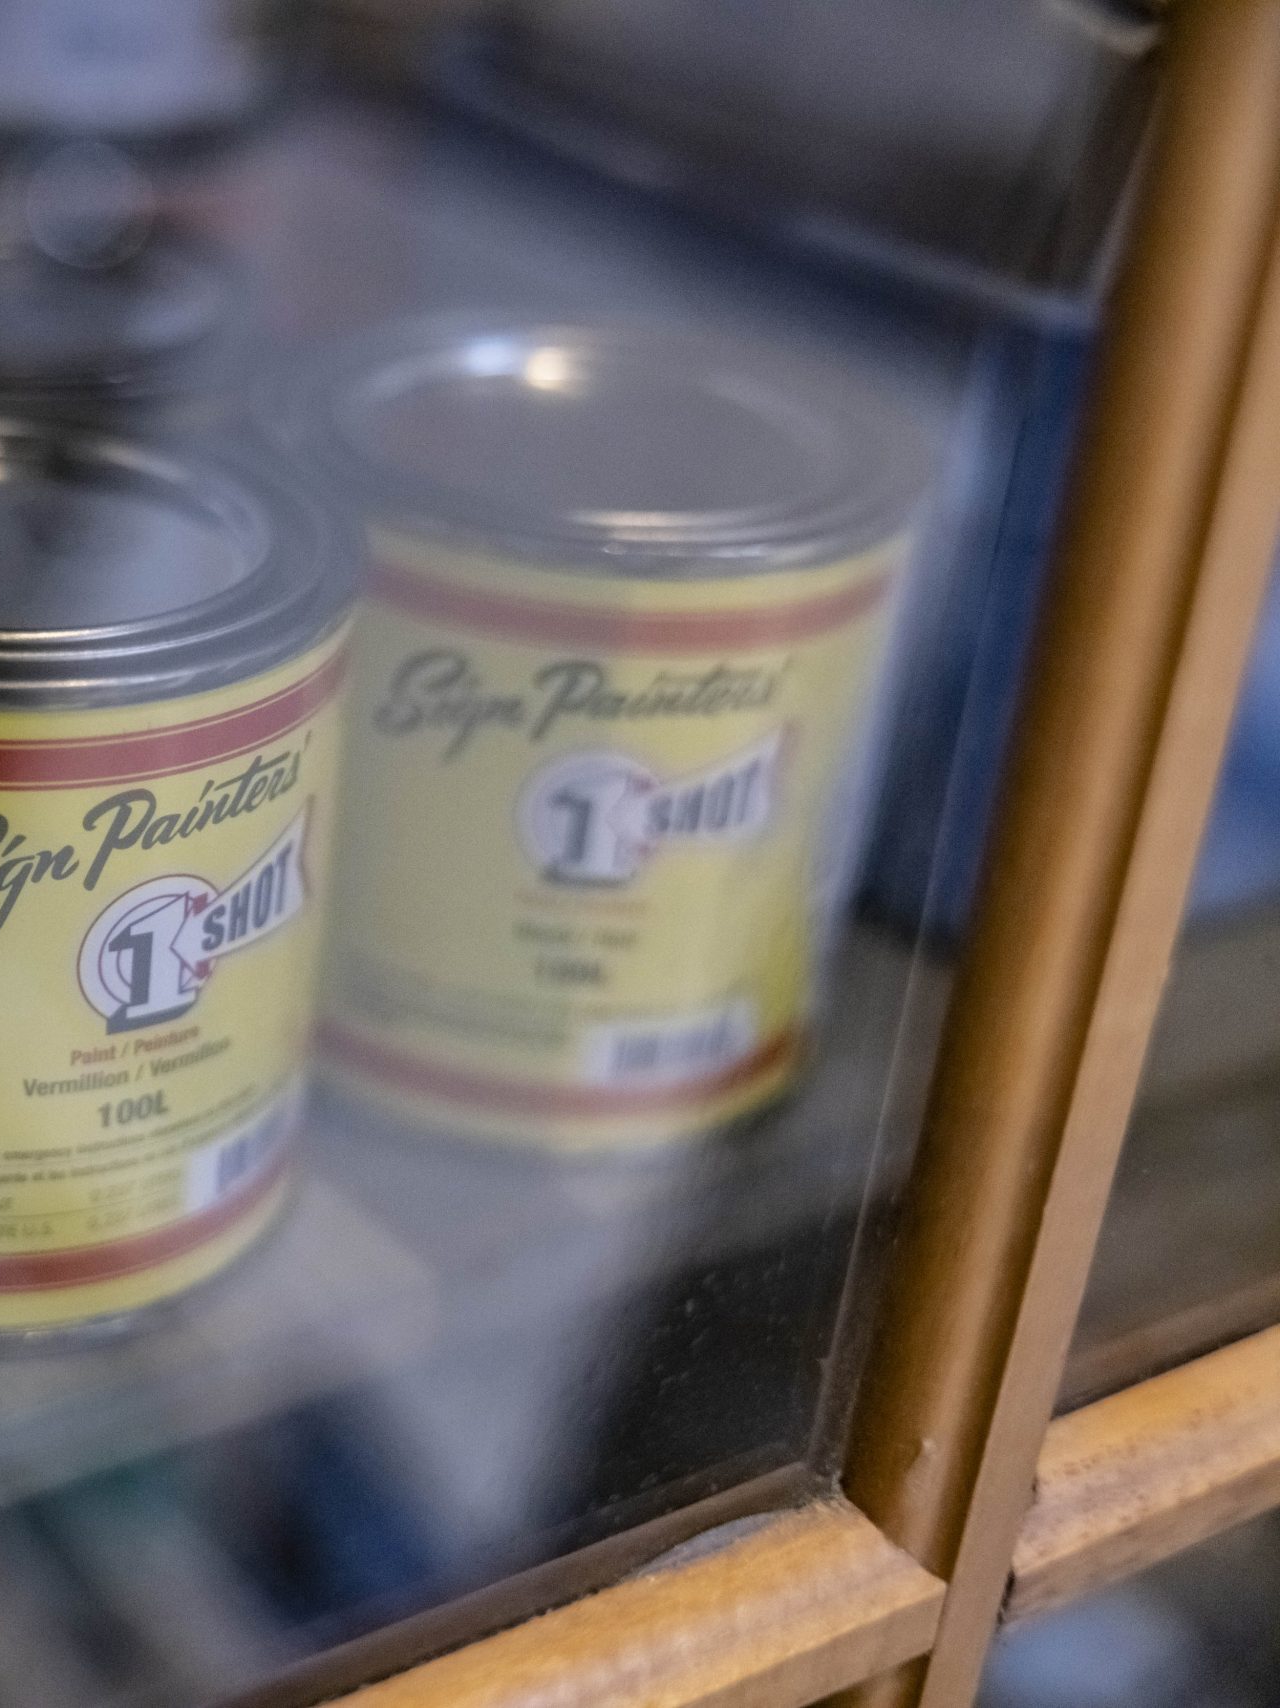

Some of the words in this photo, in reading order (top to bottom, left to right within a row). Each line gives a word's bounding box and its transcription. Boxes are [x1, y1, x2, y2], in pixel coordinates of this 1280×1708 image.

[202, 843, 293, 951] SHOT
[70, 1047, 117, 1067] Paint
[23, 1069, 130, 1098] Vermillion
[96, 1089, 171, 1128] 100L
